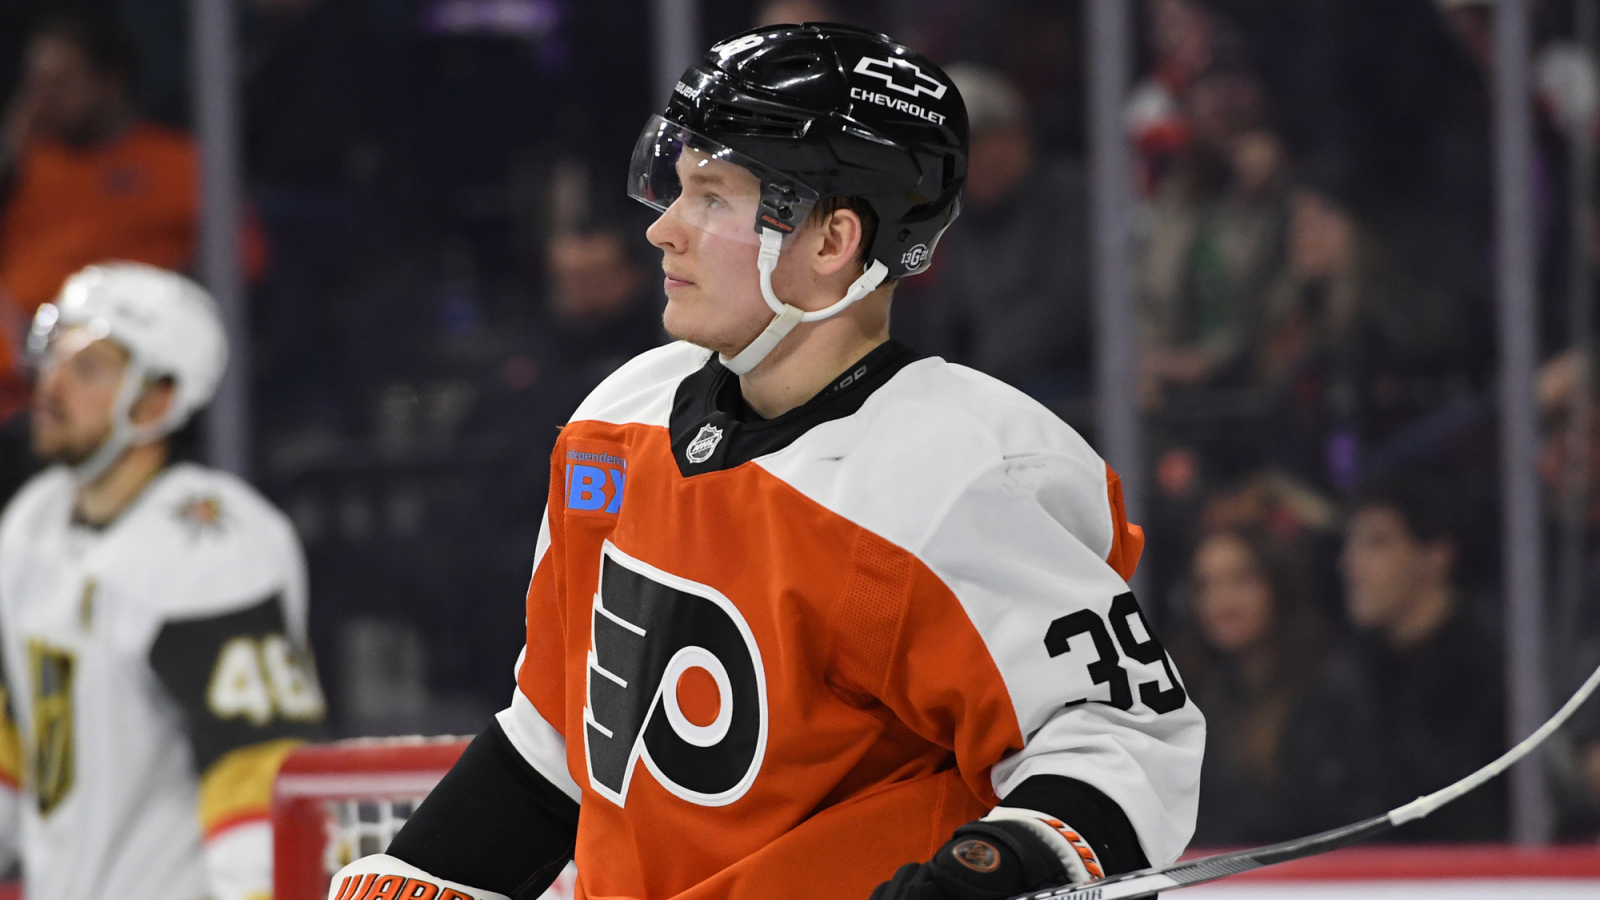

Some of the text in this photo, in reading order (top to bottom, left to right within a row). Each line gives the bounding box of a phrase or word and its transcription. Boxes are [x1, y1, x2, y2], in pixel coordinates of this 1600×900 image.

[675, 81, 701, 101] AUER
[850, 87, 947, 125] CHEVROLET
[692, 437, 716, 453] NHL
[1043, 590, 1187, 715] 39
